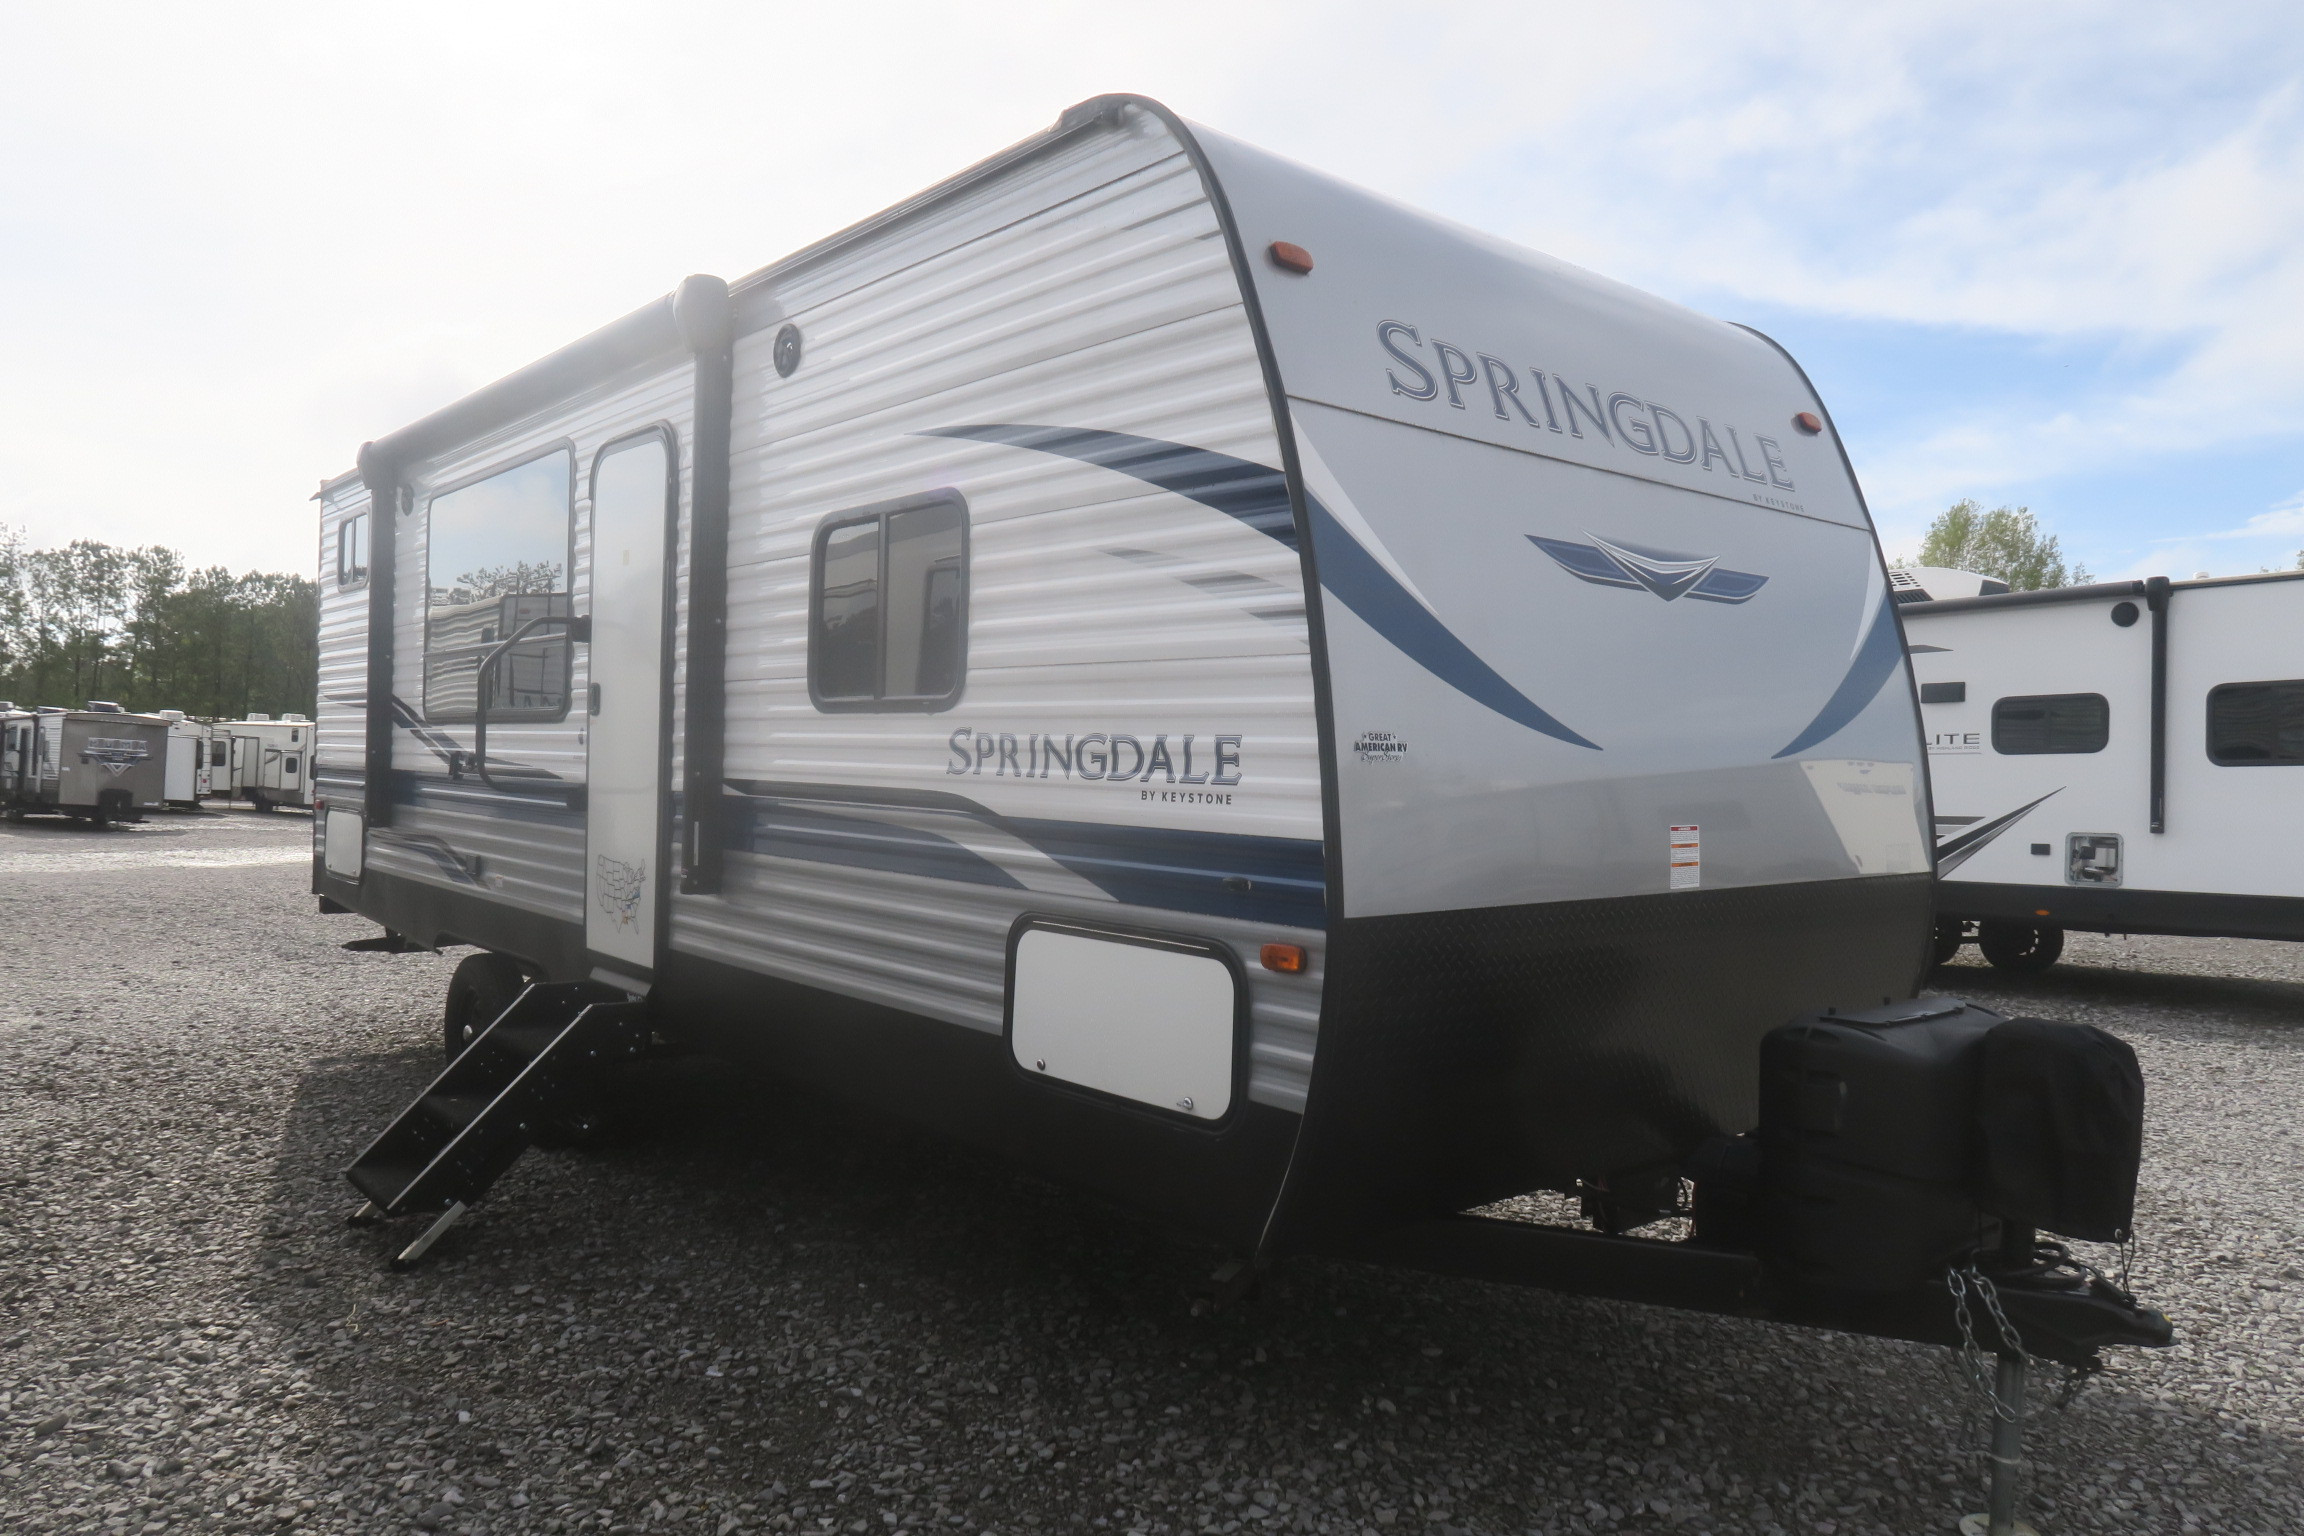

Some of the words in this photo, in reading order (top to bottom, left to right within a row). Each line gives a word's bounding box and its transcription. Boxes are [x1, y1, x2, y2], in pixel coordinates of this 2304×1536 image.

[1376, 319, 1795, 492] SPRINGDALE
[1752, 493, 1763, 502] BY
[1765, 496, 1805, 512] KEYSTONE
[1368, 733, 1392, 742] GREAT
[1926, 733, 1980, 746] ITE
[1354, 742, 1396, 752] AMERICAN
[1397, 743, 1408, 753] RV
[946, 727, 1243, 786] SPRINGDALE
[1141, 790, 1156, 801] BY
[1161, 791, 1232, 805] KEYSTONE
